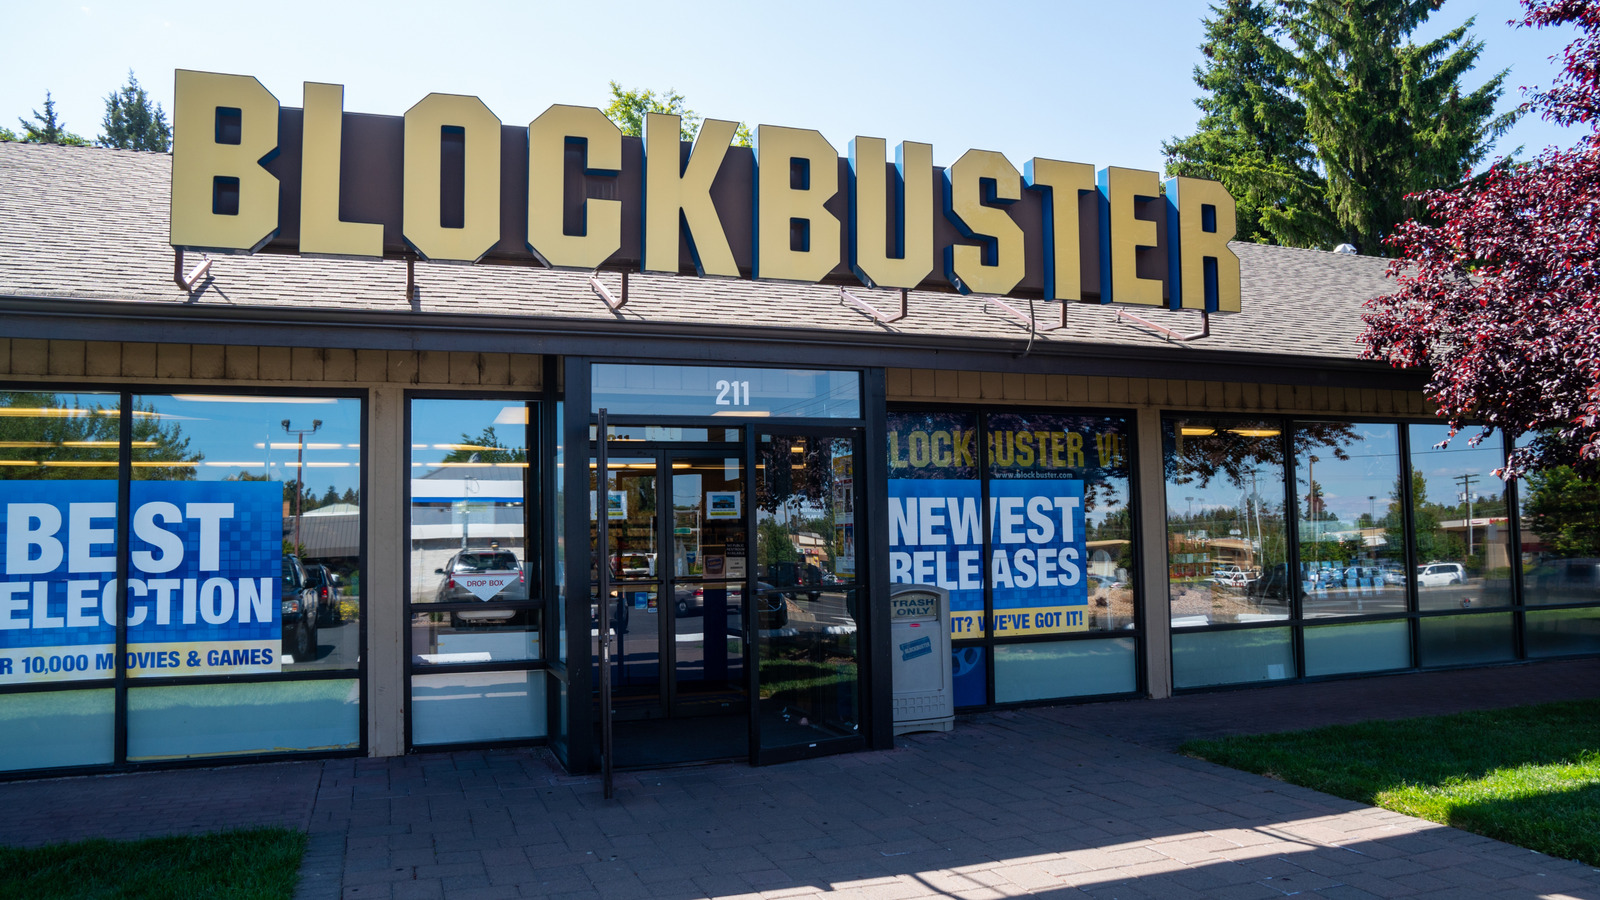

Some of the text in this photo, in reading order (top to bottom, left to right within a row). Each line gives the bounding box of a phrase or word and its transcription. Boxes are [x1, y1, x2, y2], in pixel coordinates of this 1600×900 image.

[170, 68, 1241, 313] BLOCKBUSTER
[715, 379, 750, 406] 211
[889, 430, 1126, 468] LOCKUSTER VI
[995, 471, 1073, 479] www.blockbuster.com
[888, 496, 1080, 546] NEWEST
[6, 501, 235, 575] BEST
[889, 547, 1081, 590] RELEASES
[0, 577, 273, 631] ELECTION
[892, 598, 934, 608] TRASH
[896, 607, 930, 616] ONLY
[951, 616, 973, 633] IT?
[1035, 611, 1062, 629] GOT
[1066, 610, 1083, 627] IT!
[22, 654, 89, 675] 10,000
[95, 651, 181, 670] MOVIES
[186, 650, 202, 668] &
[207, 648, 274, 667] GAMES
